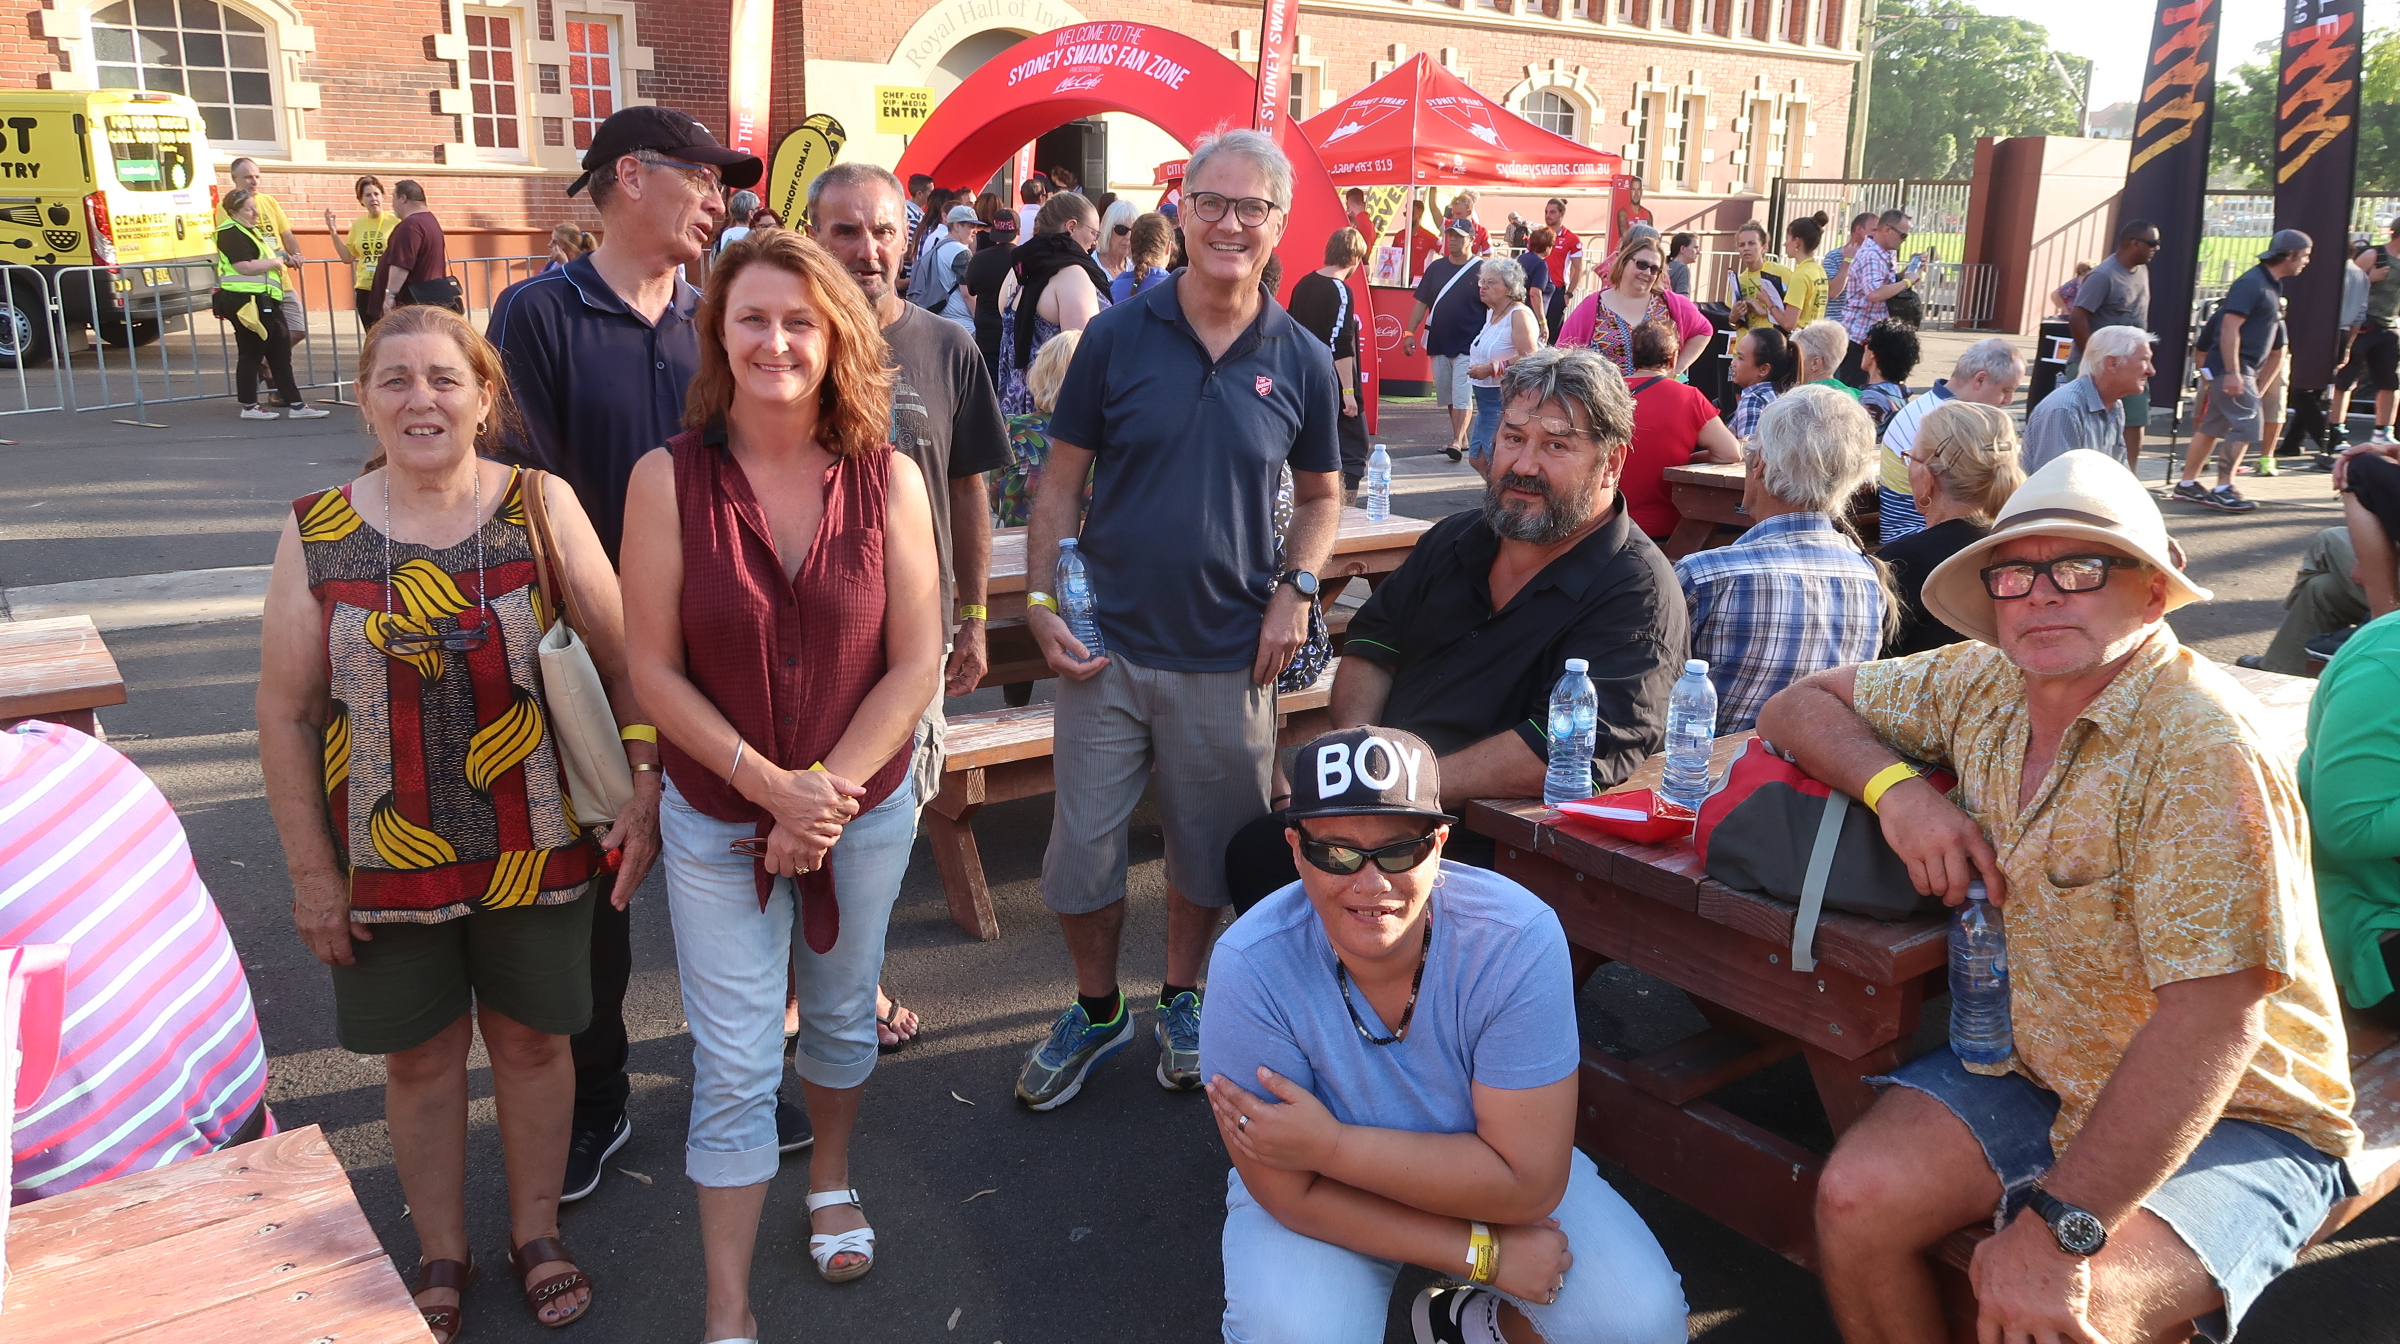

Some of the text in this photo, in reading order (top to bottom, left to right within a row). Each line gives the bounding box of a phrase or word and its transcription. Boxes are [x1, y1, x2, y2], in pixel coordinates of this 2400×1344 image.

[1269, 0, 1287, 45] SWA
[905, 12, 956, 70] Royal
[958, 0, 1001, 25] Hall
[1008, 0, 1030, 17] of
[1055, 24, 1146, 47] WELCOME TO THE
[1007, 43, 1191, 91] SYDNEY SWANS FAN ZONE
[1261, 46, 1280, 121] SYDNEY
[882, 91, 904, 99] CHEF
[1379, 96, 1408, 106] SWANS
[1426, 96, 1483, 107] SYDNEY SWANS
[883, 106, 927, 119] ENTRY
[739, 112, 755, 142] THE
[1374, 158, 1393, 171] 819
[1495, 160, 1611, 179] sydneyswans.com.au
[115, 213, 167, 226] OZHARVEST
[1316, 736, 1422, 802] BOY
